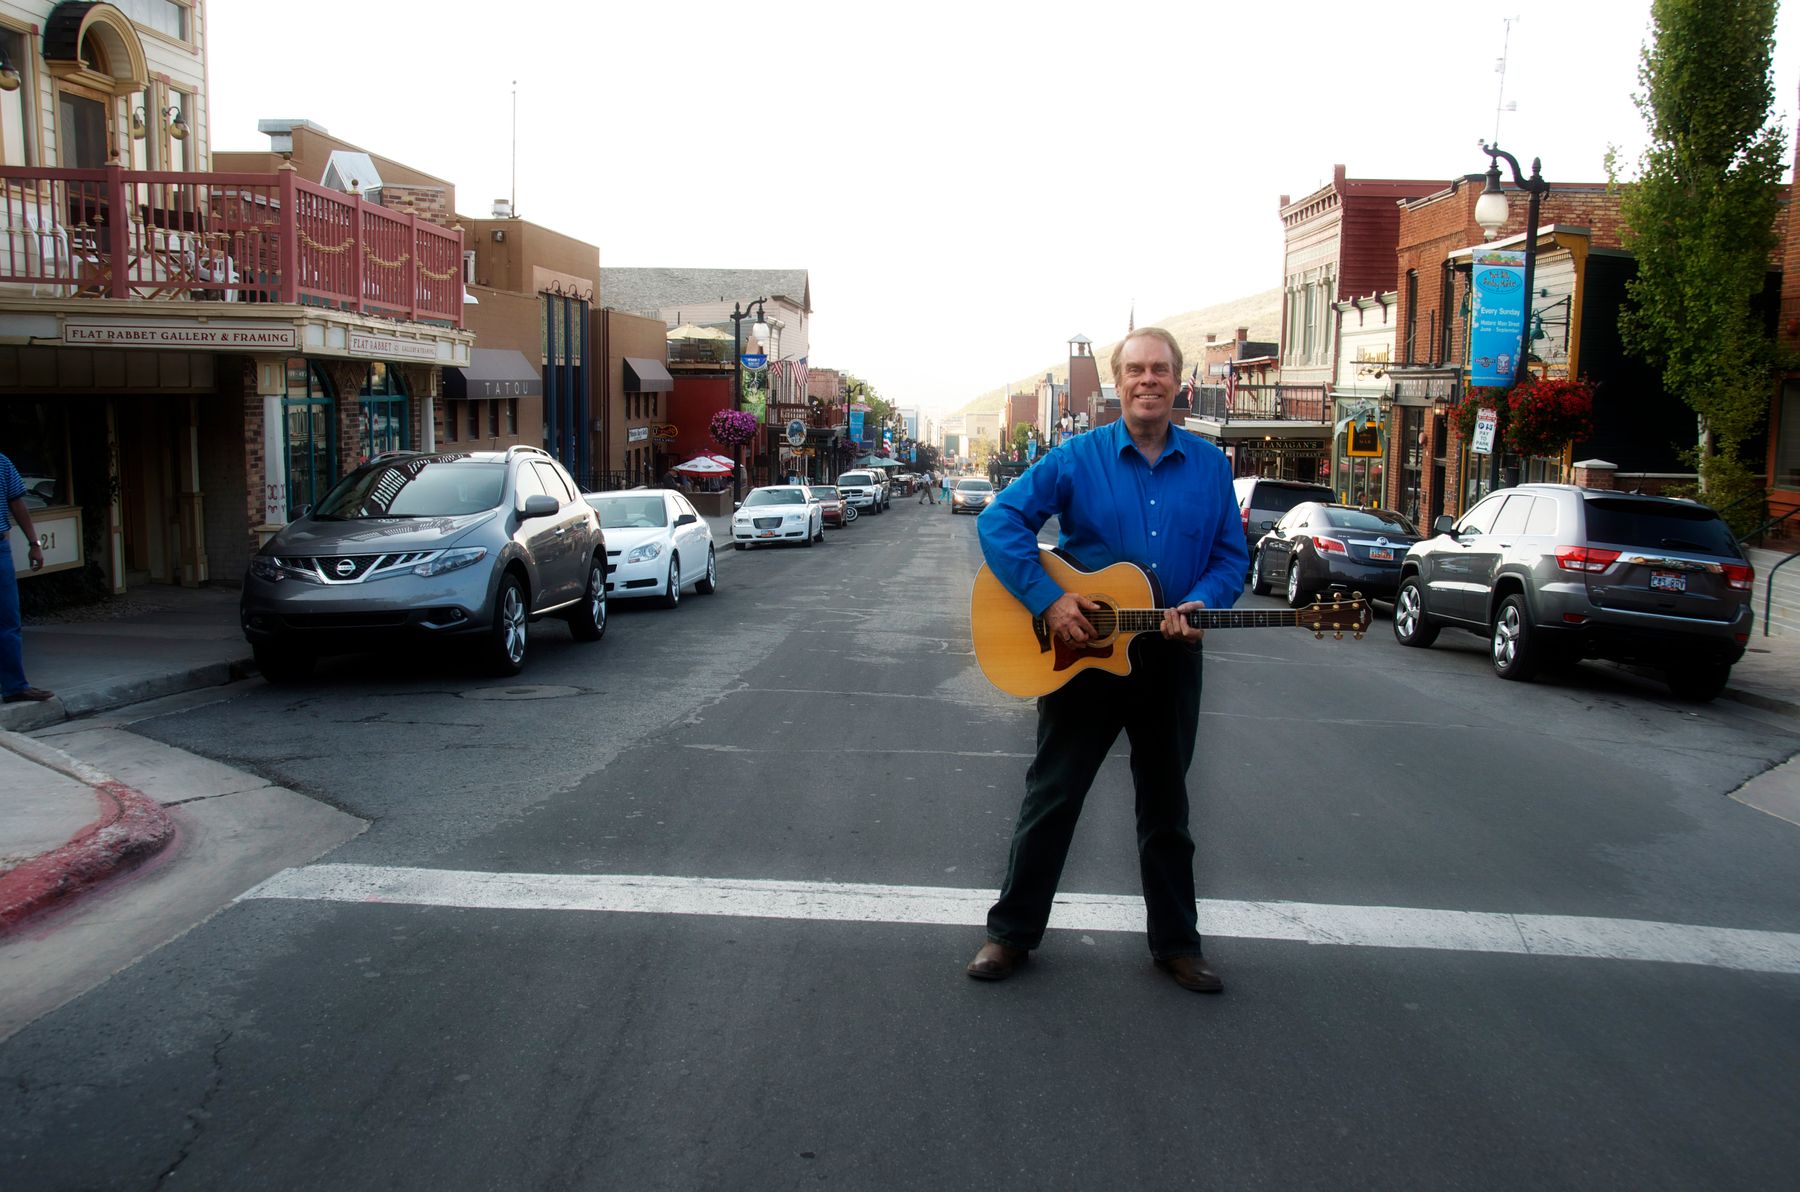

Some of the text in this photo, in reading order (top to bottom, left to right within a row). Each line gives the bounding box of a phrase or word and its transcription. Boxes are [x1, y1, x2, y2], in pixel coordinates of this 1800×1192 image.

[1481, 307, 1520, 316] Every Sunday
[72, 329, 289, 343] FLAT RABBET GALLERY & FRAMING
[353, 338, 368, 350] FLAT
[485, 382, 528, 395] TATOU
[1257, 441, 1317, 449] FLANAGAN'S
